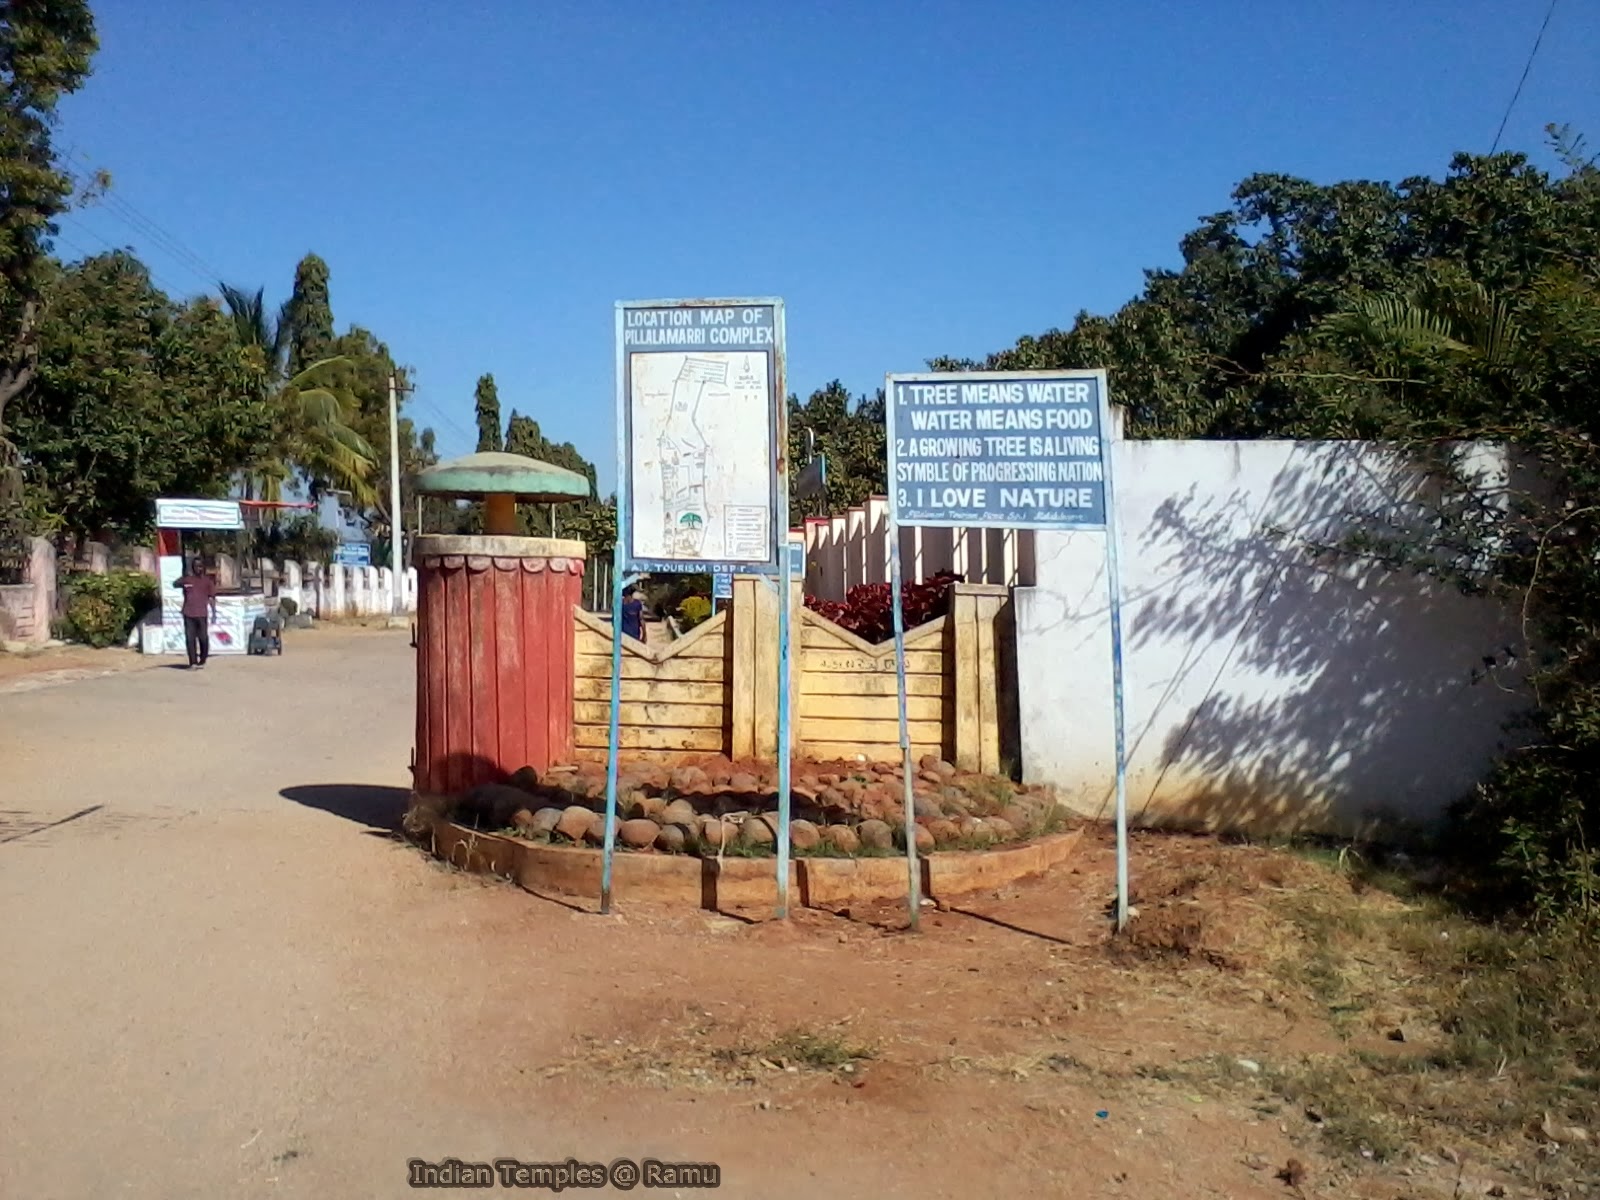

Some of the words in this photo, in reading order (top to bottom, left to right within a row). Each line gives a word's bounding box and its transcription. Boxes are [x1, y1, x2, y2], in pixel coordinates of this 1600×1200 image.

[627, 310, 692, 327] LOCATION
[700, 309, 735, 325] MAP
[742, 308, 764, 324] OF
[625, 329, 705, 345] PILLALAMARRI
[710, 327, 774, 344] COMPLEX
[910, 385, 957, 405] TREE
[961, 384, 1024, 405] MEANS
[1027, 383, 1089, 403] WATER
[911, 410, 972, 431] WATER
[976, 409, 1043, 430] MEANS
[1046, 408, 1093, 429] FOOD
[983, 436, 1026, 456] TREE
[897, 462, 949, 482] SYMBLE
[952, 463, 969, 481] OF
[971, 462, 1057, 482] PROGRESSING
[1058, 461, 1103, 481] NATION
[930, 488, 986, 508] LOVE
[1000, 488, 1093, 508] NATURE
[654, 563, 706, 573] TOURISM
